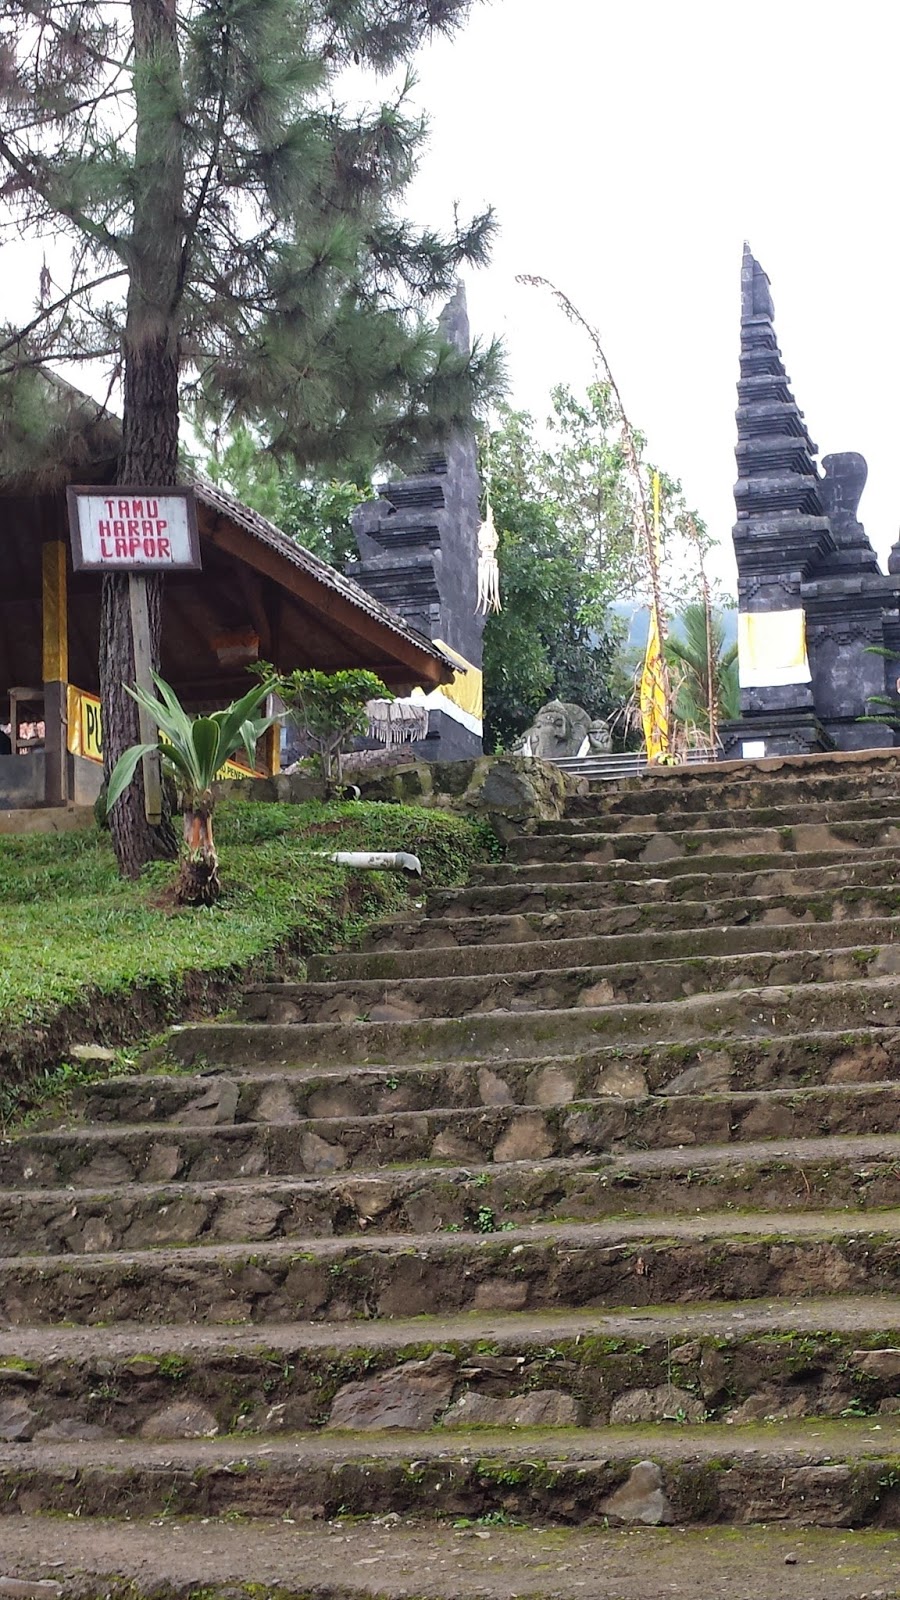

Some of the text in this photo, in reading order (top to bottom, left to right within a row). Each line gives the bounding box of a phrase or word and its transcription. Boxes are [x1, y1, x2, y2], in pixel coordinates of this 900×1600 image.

[104, 500, 158, 518] TAMU
[98, 520, 168, 536] HARAP
[101, 538, 170, 557] LAPOR
